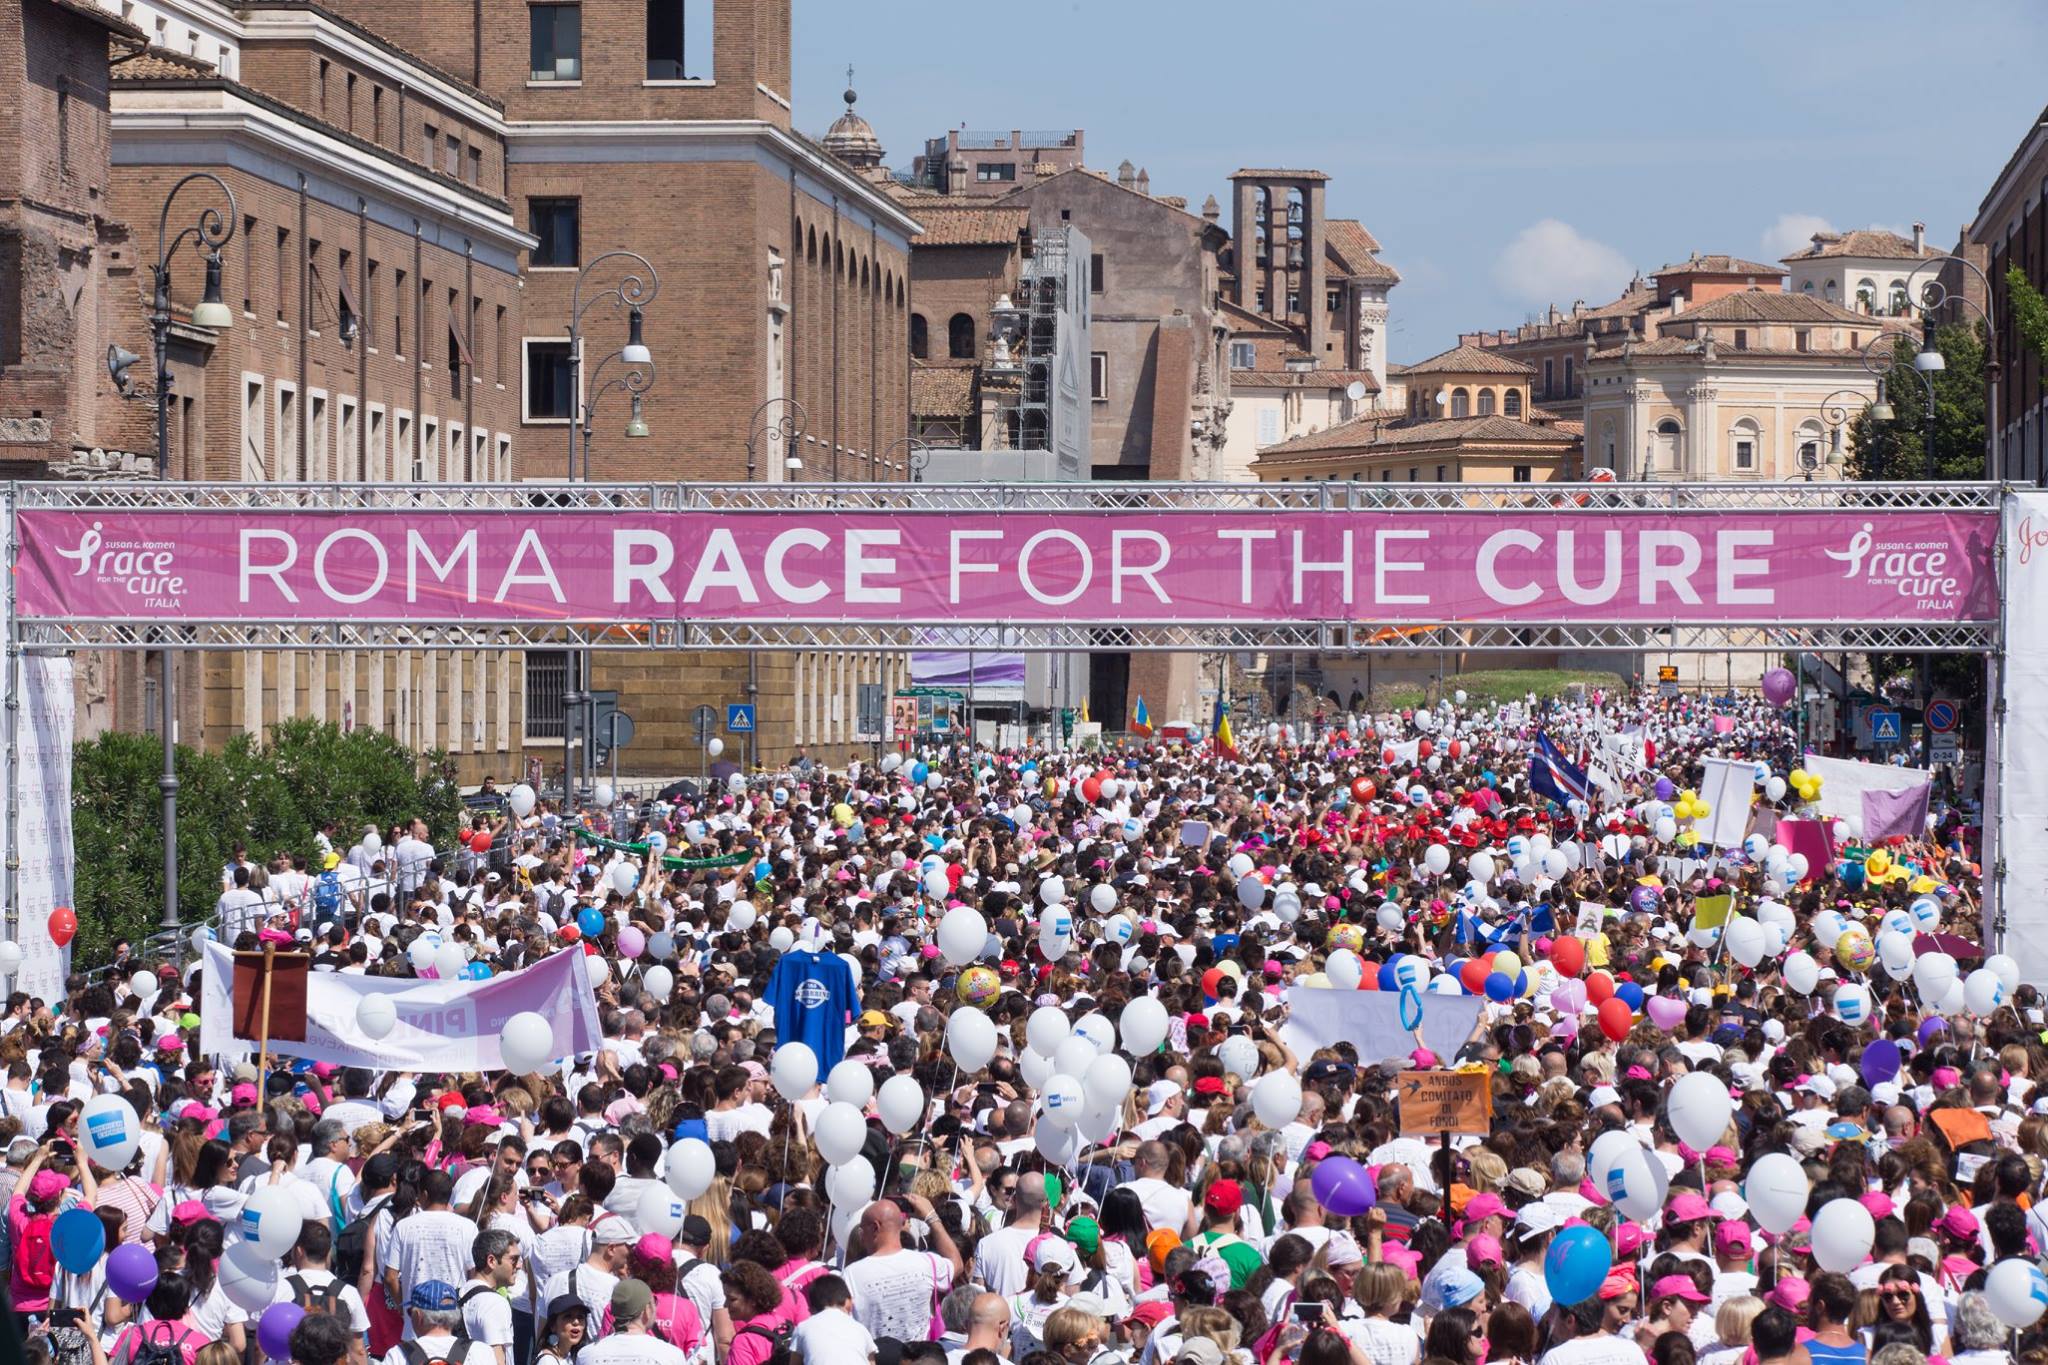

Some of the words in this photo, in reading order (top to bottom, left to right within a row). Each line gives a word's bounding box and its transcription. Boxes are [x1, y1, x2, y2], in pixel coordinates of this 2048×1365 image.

[98, 551, 174, 576] race
[240, 528, 566, 604] ROMA
[613, 528, 901, 604] RACE
[949, 529, 1173, 606] FOR
[1217, 529, 1430, 604] THE
[1475, 528, 1774, 606] CURE
[1868, 552, 1947, 577] race
[144, 598, 181, 608] ITALIA
[1916, 599, 1954, 610] ITALIA
[1933, 751, 1953, 759] 0-24
[1420, 1090, 1473, 1103] COMITATO
